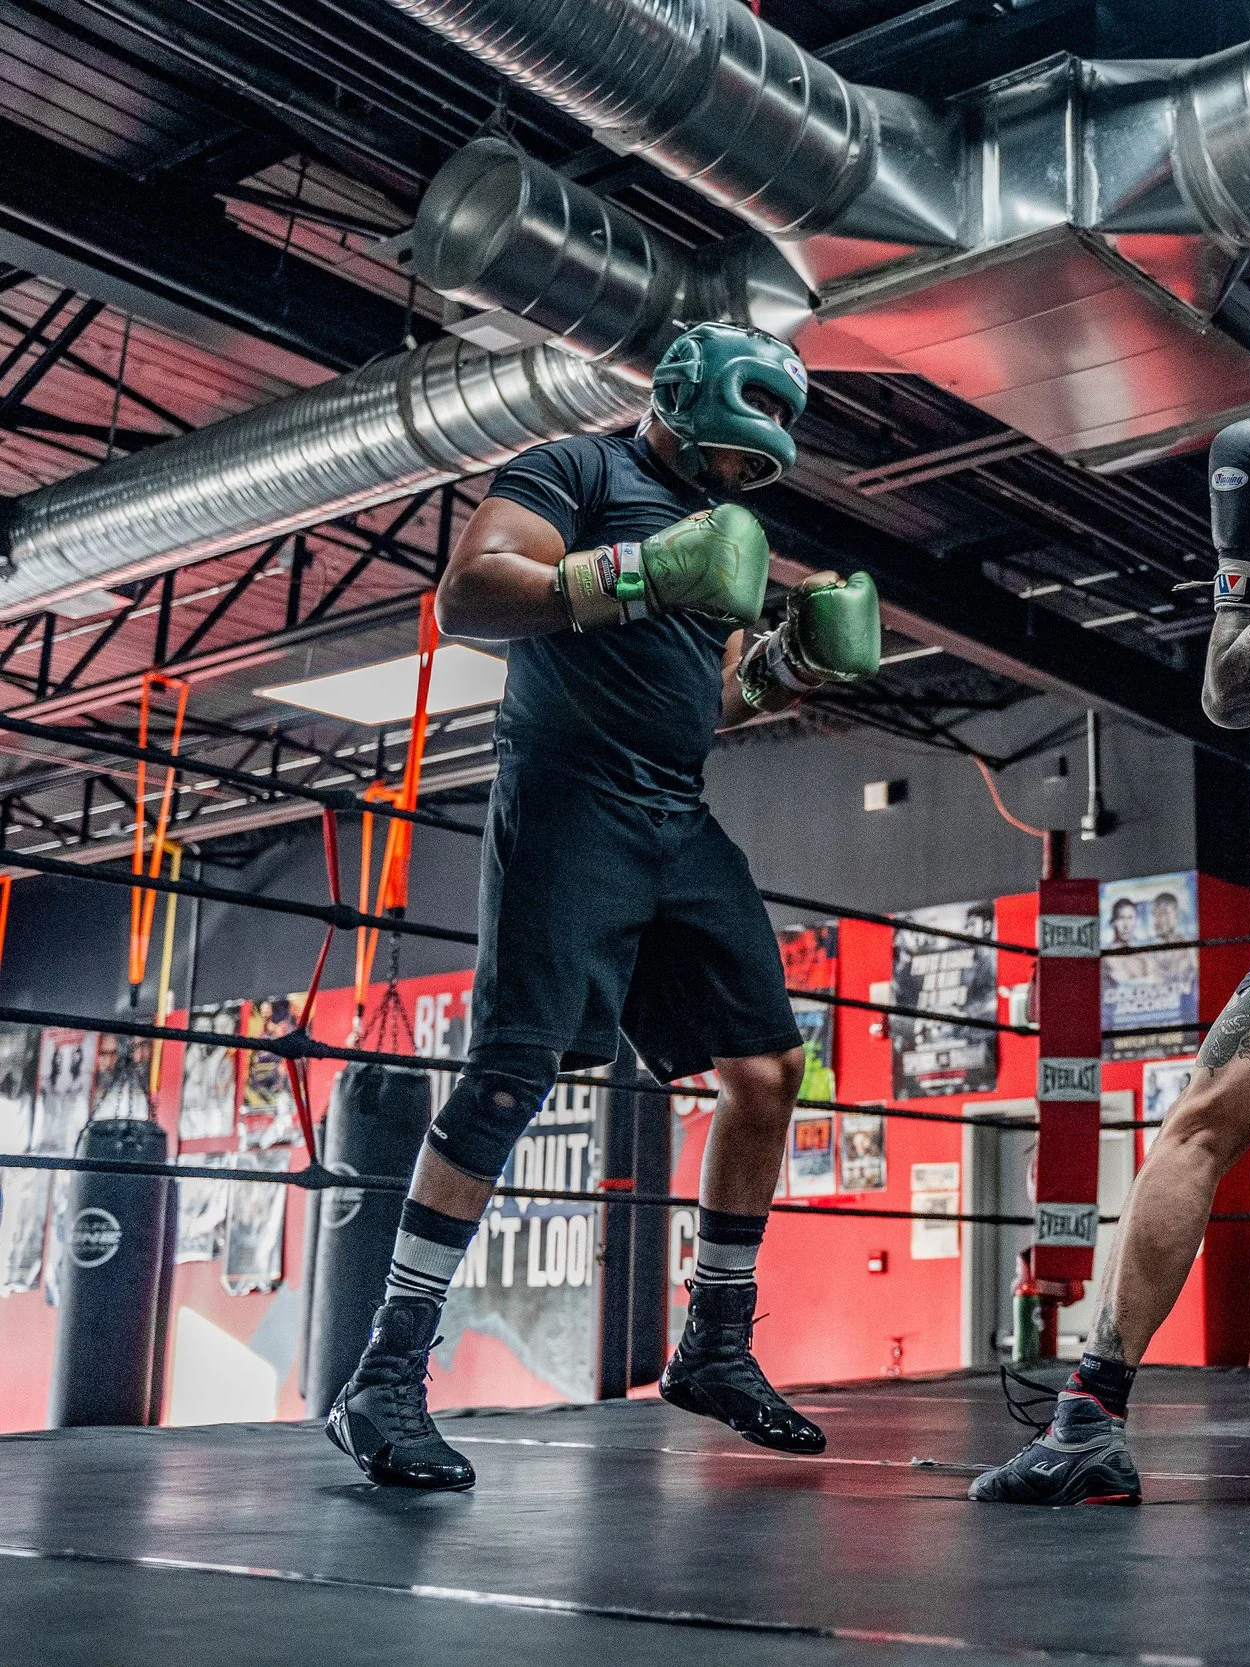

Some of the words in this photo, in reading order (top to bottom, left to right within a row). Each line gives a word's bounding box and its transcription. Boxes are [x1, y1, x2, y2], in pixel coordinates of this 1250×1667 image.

[1042, 921, 1097, 950] EVERLAST
[414, 992, 453, 1059] BE
[1042, 1063, 1097, 1094] EVERLAST
[1039, 1210, 1093, 1241] EVERLAST
